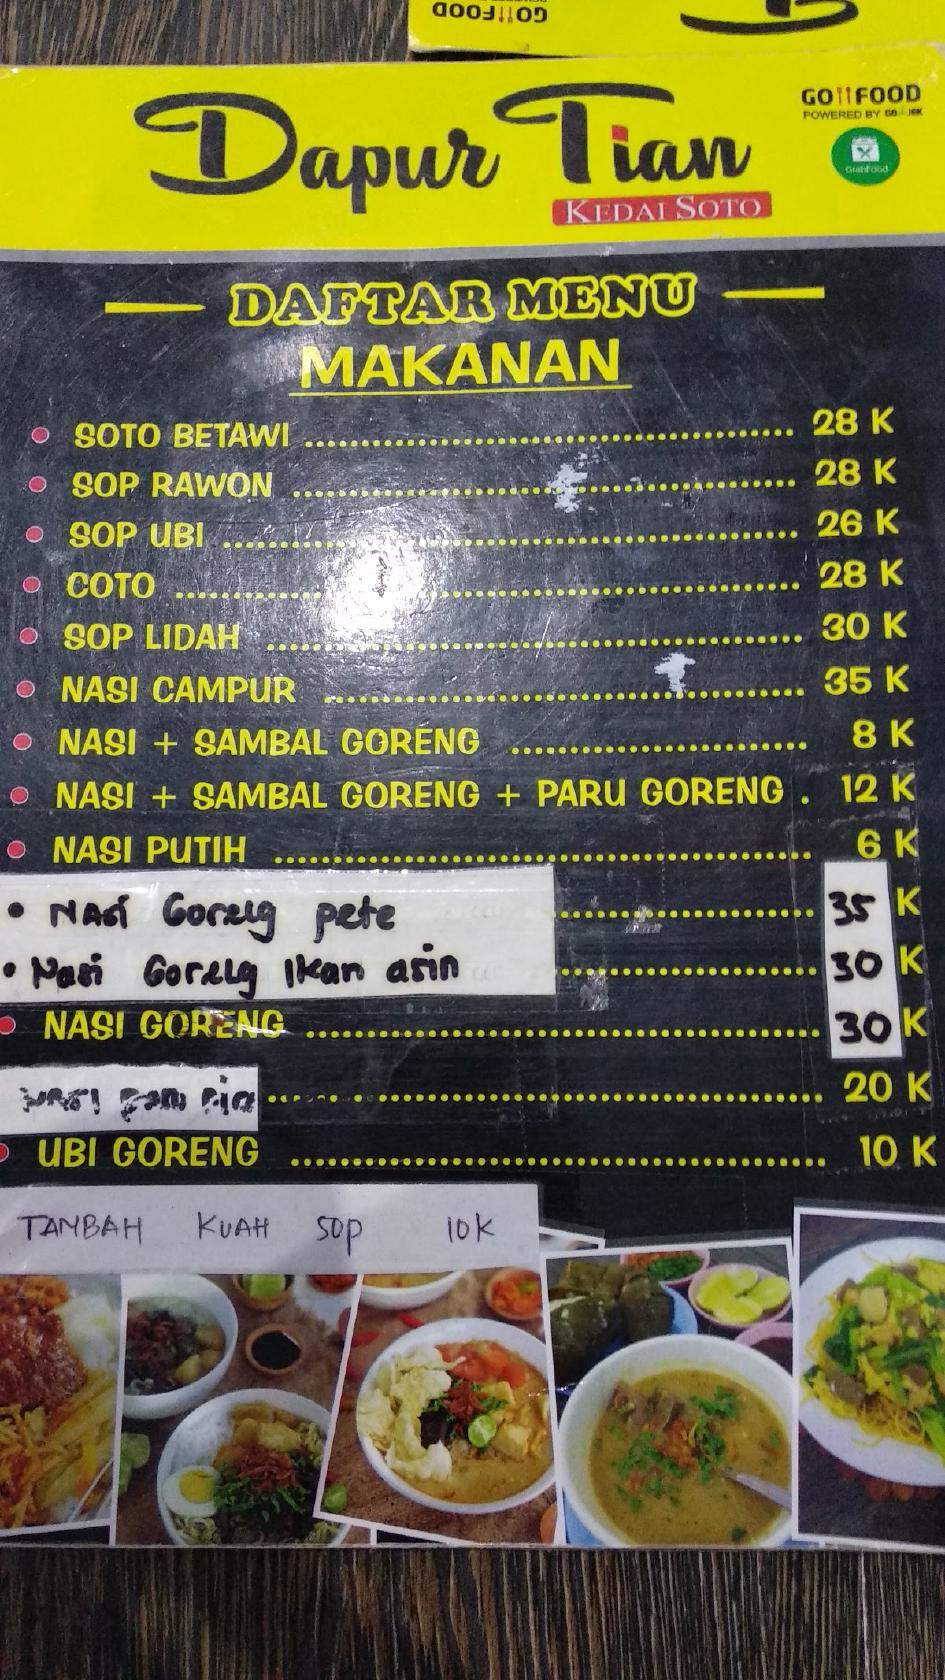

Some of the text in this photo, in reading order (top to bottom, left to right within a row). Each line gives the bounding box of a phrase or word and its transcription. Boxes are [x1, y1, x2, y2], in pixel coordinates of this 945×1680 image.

[803, 110, 862, 120] POWERED
[865, 109, 881, 119] BY
[134, 82, 752, 214] Dapur Tian
[564, 195, 762, 224] KEDAI SOTO
[228, 271, 697, 327] DAFTAR MENU
[301, 338, 619, 389] MAKANAN
[73, 407, 892, 448] SOTO BETAWI 28 K
[72, 457, 896, 498] SOP RAWON 28 K
[69, 508, 897, 548] SOP UBI 26 K
[66, 559, 901, 599] COTO 28 K
[64, 610, 905, 651] SOP LIDAH 30 K
[62, 664, 908, 704] NASI CAMPUR 35 K
[59, 718, 912, 757] NASI + SAMBAL GORENG 8 K
[57, 773, 913, 810] NASI + SAMBAL GORENG + PARU GORENG 12 K
[53, 829, 916, 864] NASI PUTIH 6 K
[829, 891, 875, 926] 35
[897, 886, 919, 916] K
[831, 950, 882, 982] 30
[900, 945, 922, 974] K
[45, 1009, 284, 1040] NASI GORENG
[835, 1011, 891, 1043] 30
[903, 1007, 925, 1037] K
[844, 1071, 929, 1102] 20 K
[39, 1135, 936, 1167] UBI GORENG 10 K
[17, 1214, 143, 1245] TAMBAH
[198, 1212, 270, 1240] KUAH
